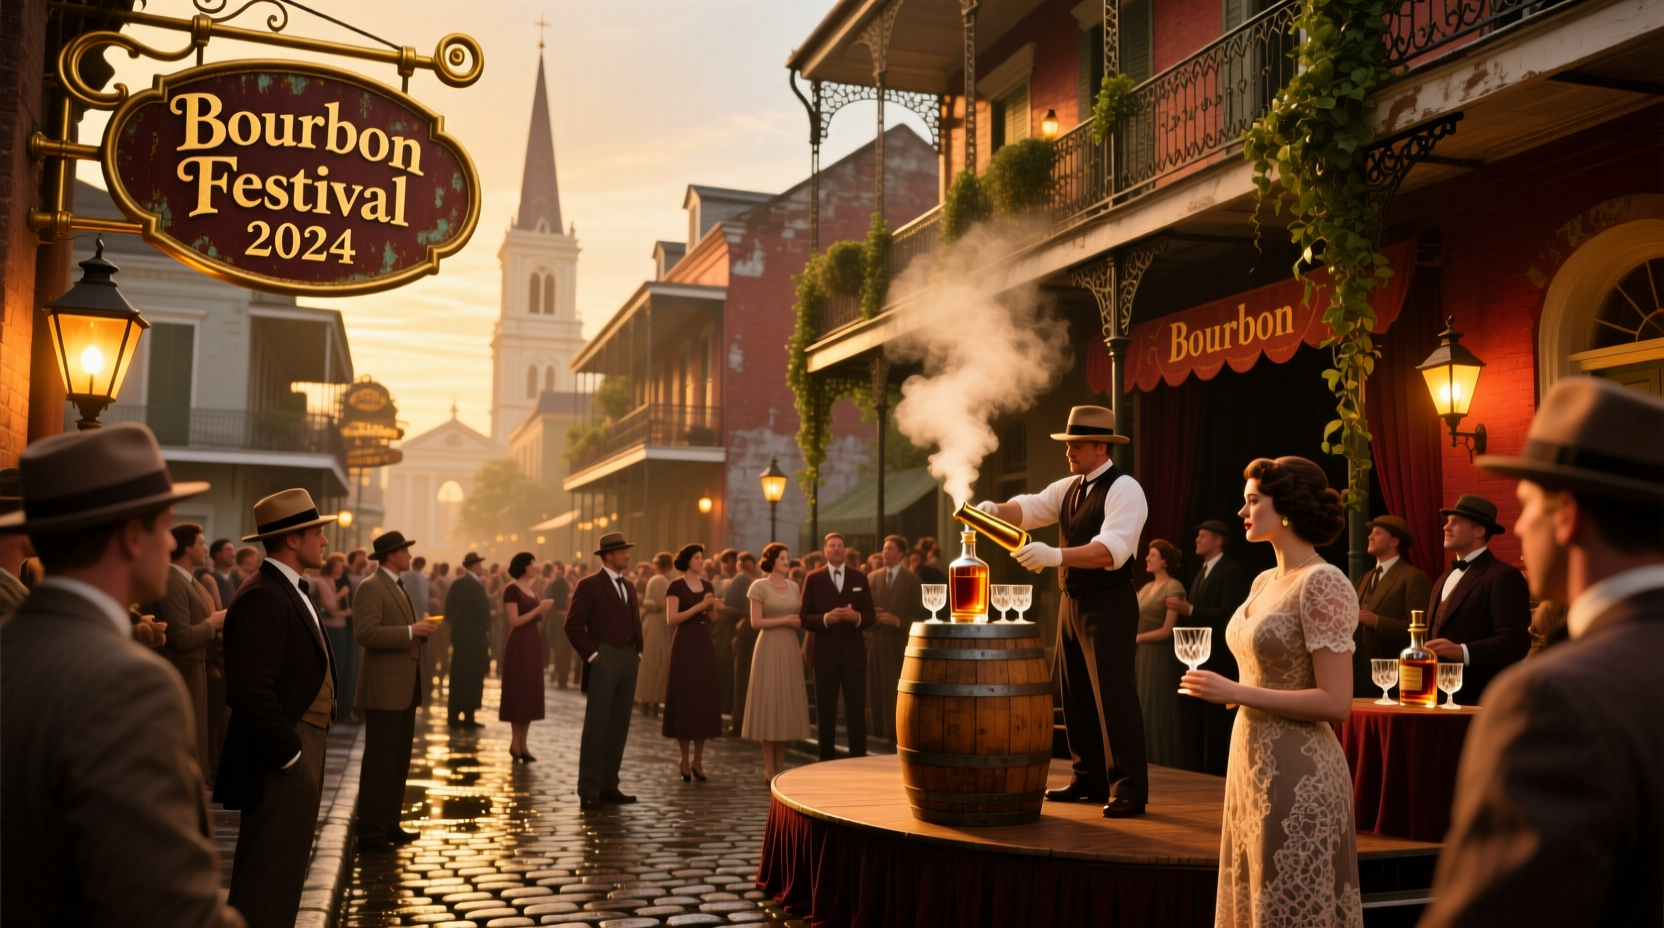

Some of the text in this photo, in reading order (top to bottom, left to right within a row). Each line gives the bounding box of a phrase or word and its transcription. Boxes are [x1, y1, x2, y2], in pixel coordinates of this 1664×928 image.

[169, 92, 424, 176] Bourbon
[176, 155, 409, 227] Festival
[244, 220, 356, 265] 2024
[1168, 303, 1294, 363] Bourbon
